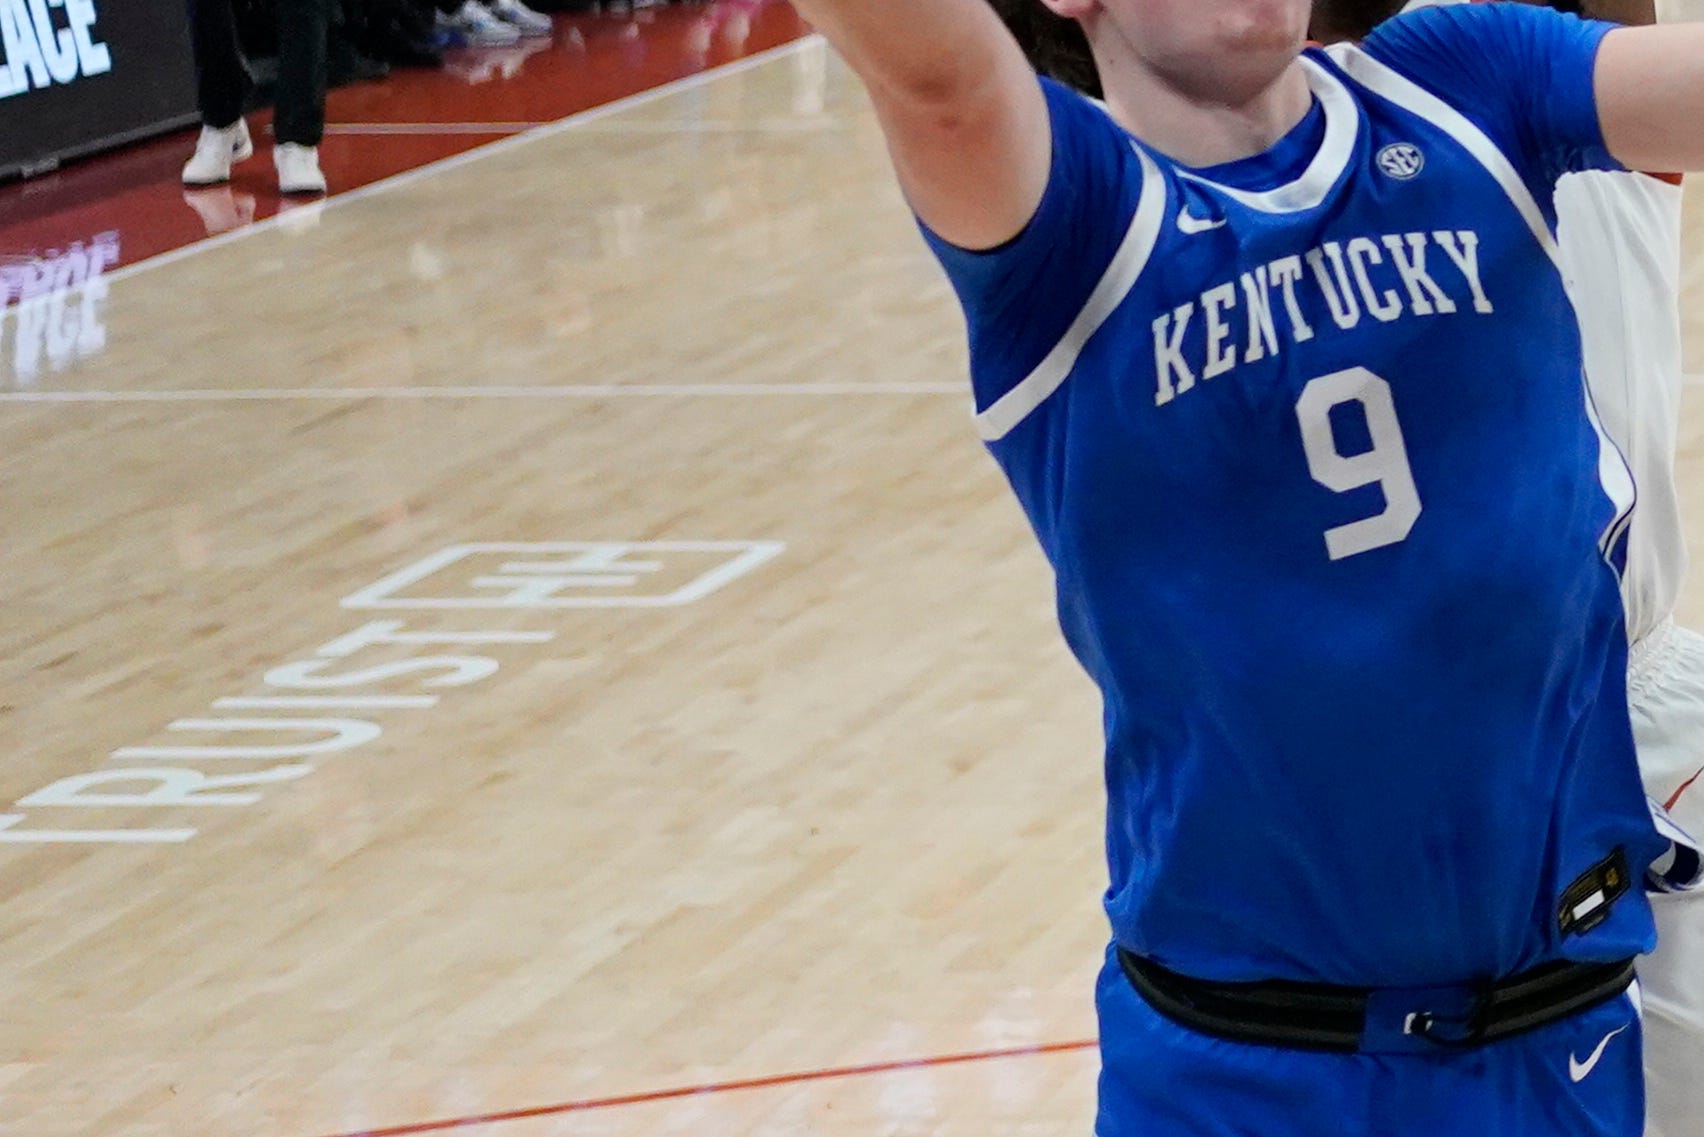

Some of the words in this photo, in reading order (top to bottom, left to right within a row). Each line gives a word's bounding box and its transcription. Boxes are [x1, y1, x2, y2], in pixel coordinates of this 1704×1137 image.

[1381, 147, 1420, 176] SEC
[1152, 230, 1494, 407] KENTUCKY
[1296, 366, 1423, 561] 9
